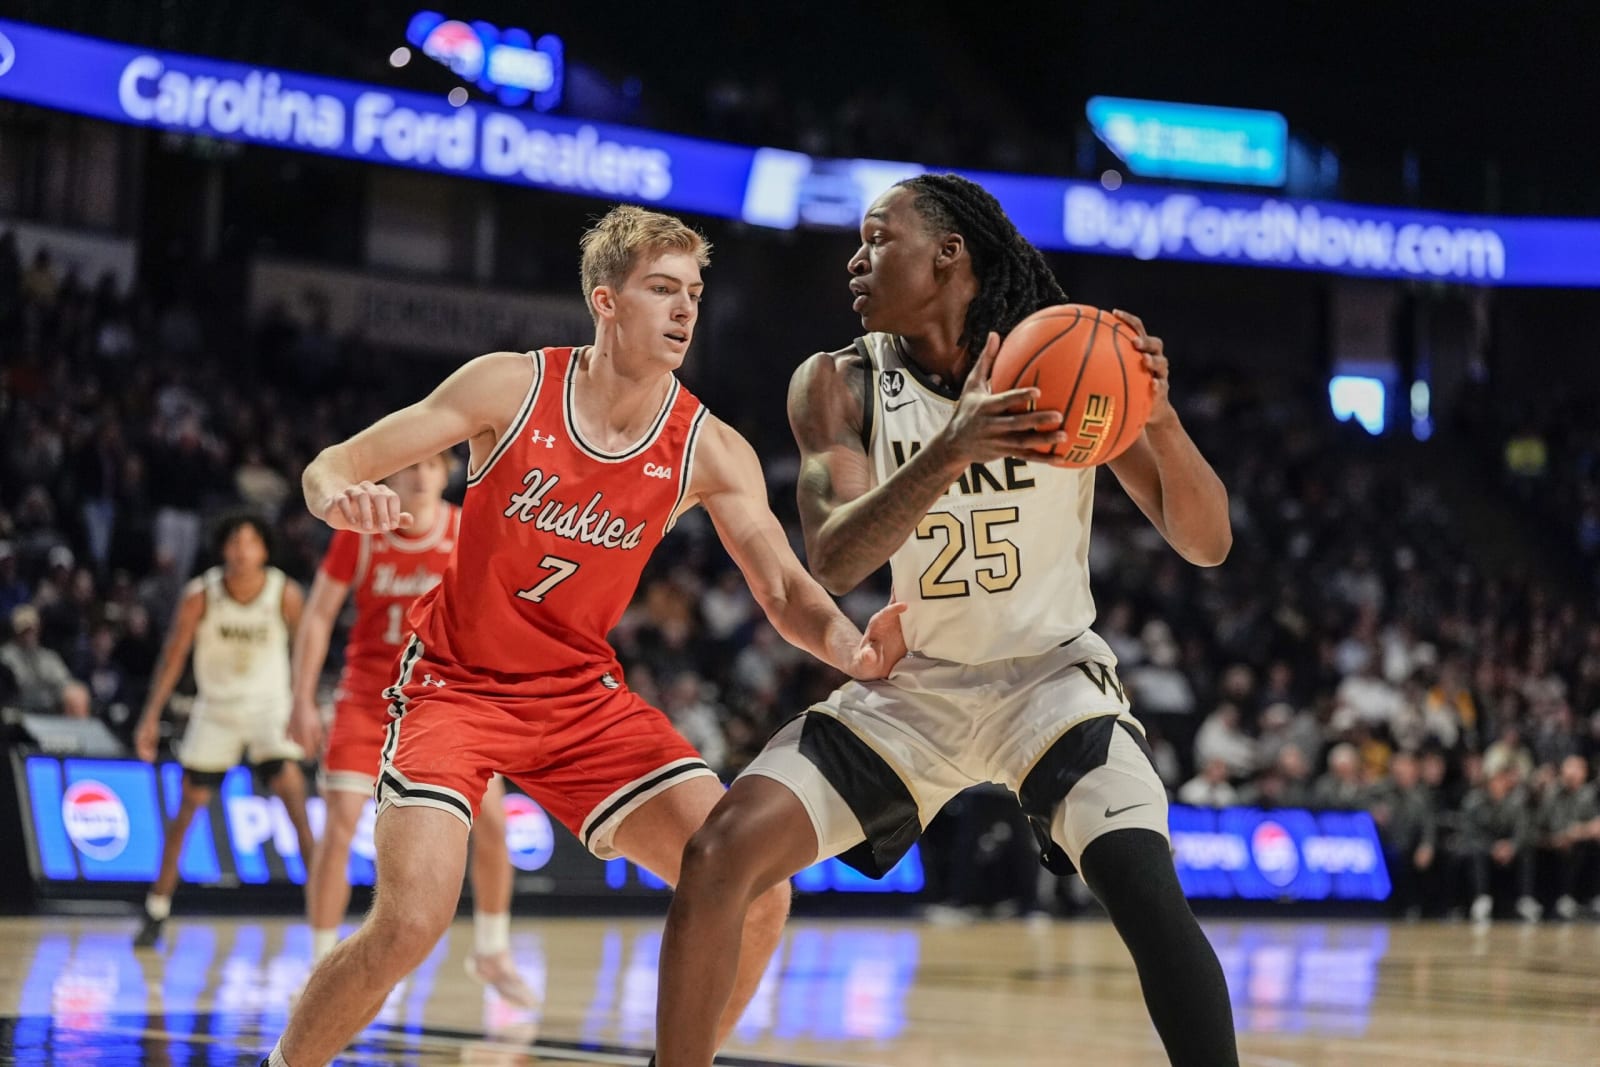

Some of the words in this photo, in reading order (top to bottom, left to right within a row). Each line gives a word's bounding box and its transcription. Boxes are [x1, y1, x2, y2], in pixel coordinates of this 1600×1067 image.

[118, 55, 346, 150] Carolina
[352, 92, 478, 170] Ford
[480, 112, 673, 202] Dealers
[1063, 185, 1507, 281] BuyFordNow.com
[882, 372, 902, 392] 54
[1062, 393, 1110, 464] ELITE
[642, 461, 673, 480] CAA
[504, 468, 647, 550] Huskies
[515, 554, 580, 604] 7
[914, 505, 1023, 600] 25
